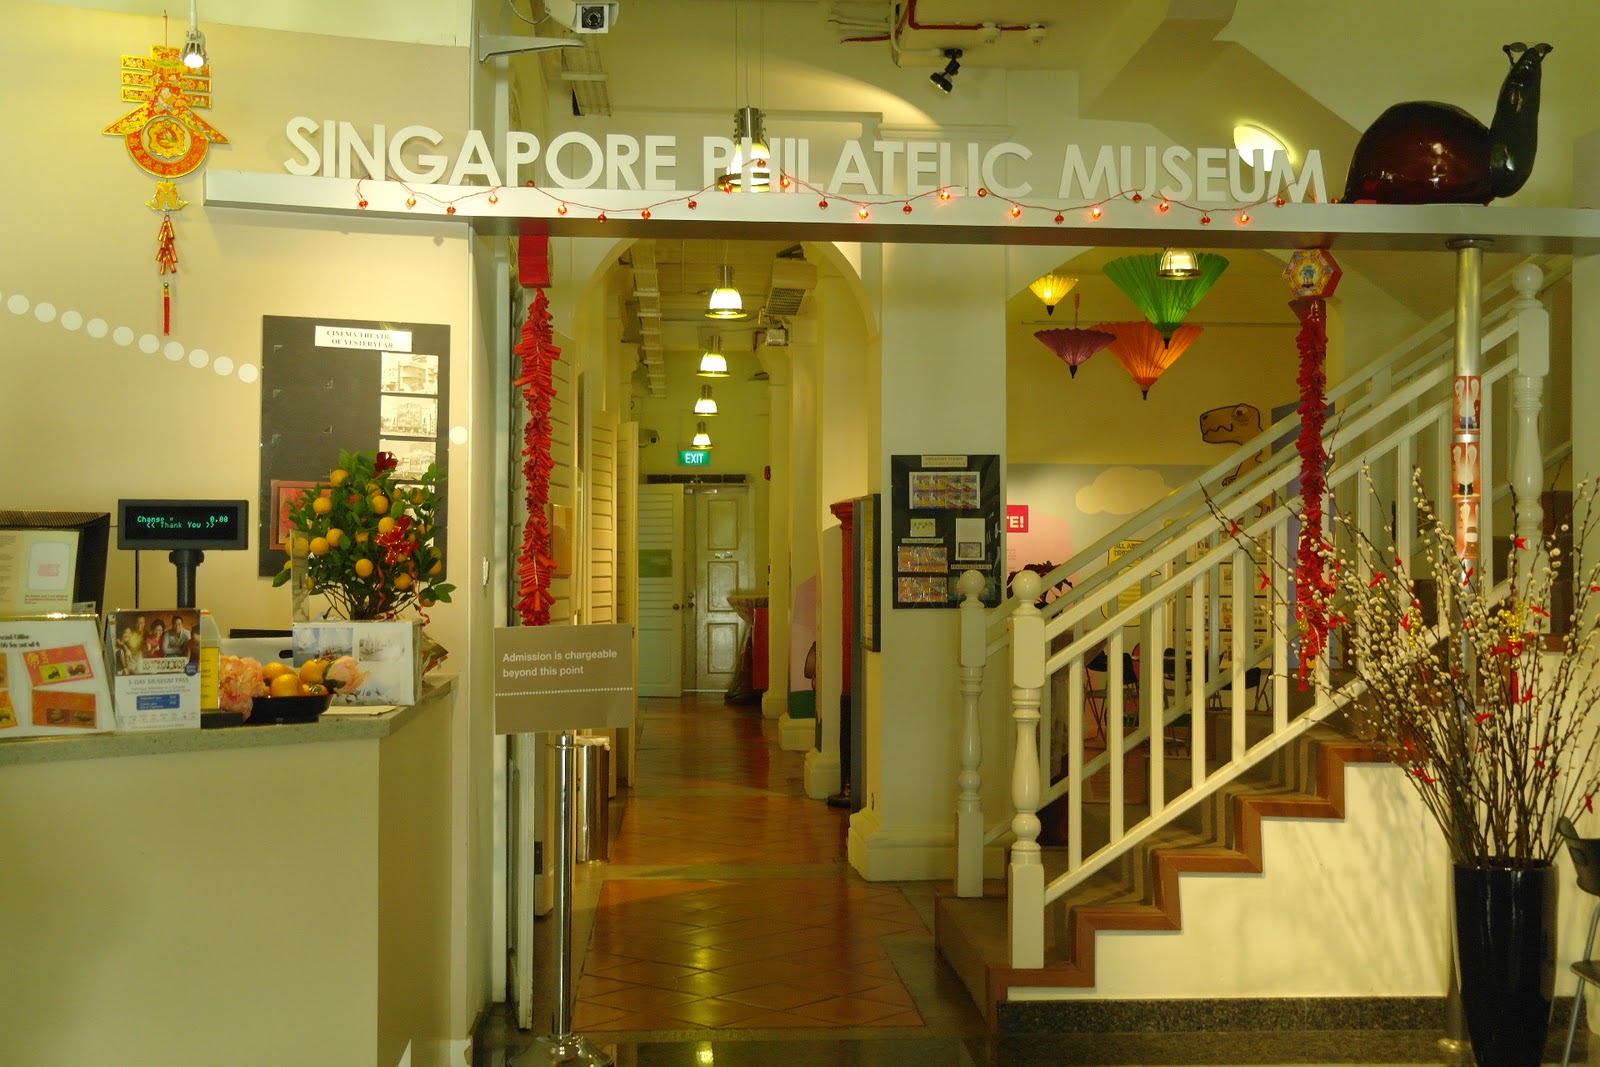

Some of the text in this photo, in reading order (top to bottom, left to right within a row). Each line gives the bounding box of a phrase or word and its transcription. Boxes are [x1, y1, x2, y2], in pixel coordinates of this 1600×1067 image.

[283, 116, 1328, 204] SINGAPORE PHILATELIC MUSEUM
[326, 329, 358, 338] CINEMA
[684, 452, 704, 464] EXIT
[137, 515, 165, 523] Change
[1006, 515, 1024, 528] E!
[502, 649, 618, 662] Admission is chargeable
[502, 665, 584, 679] beyond this point
[147, 677, 174, 685] MUSEUM
